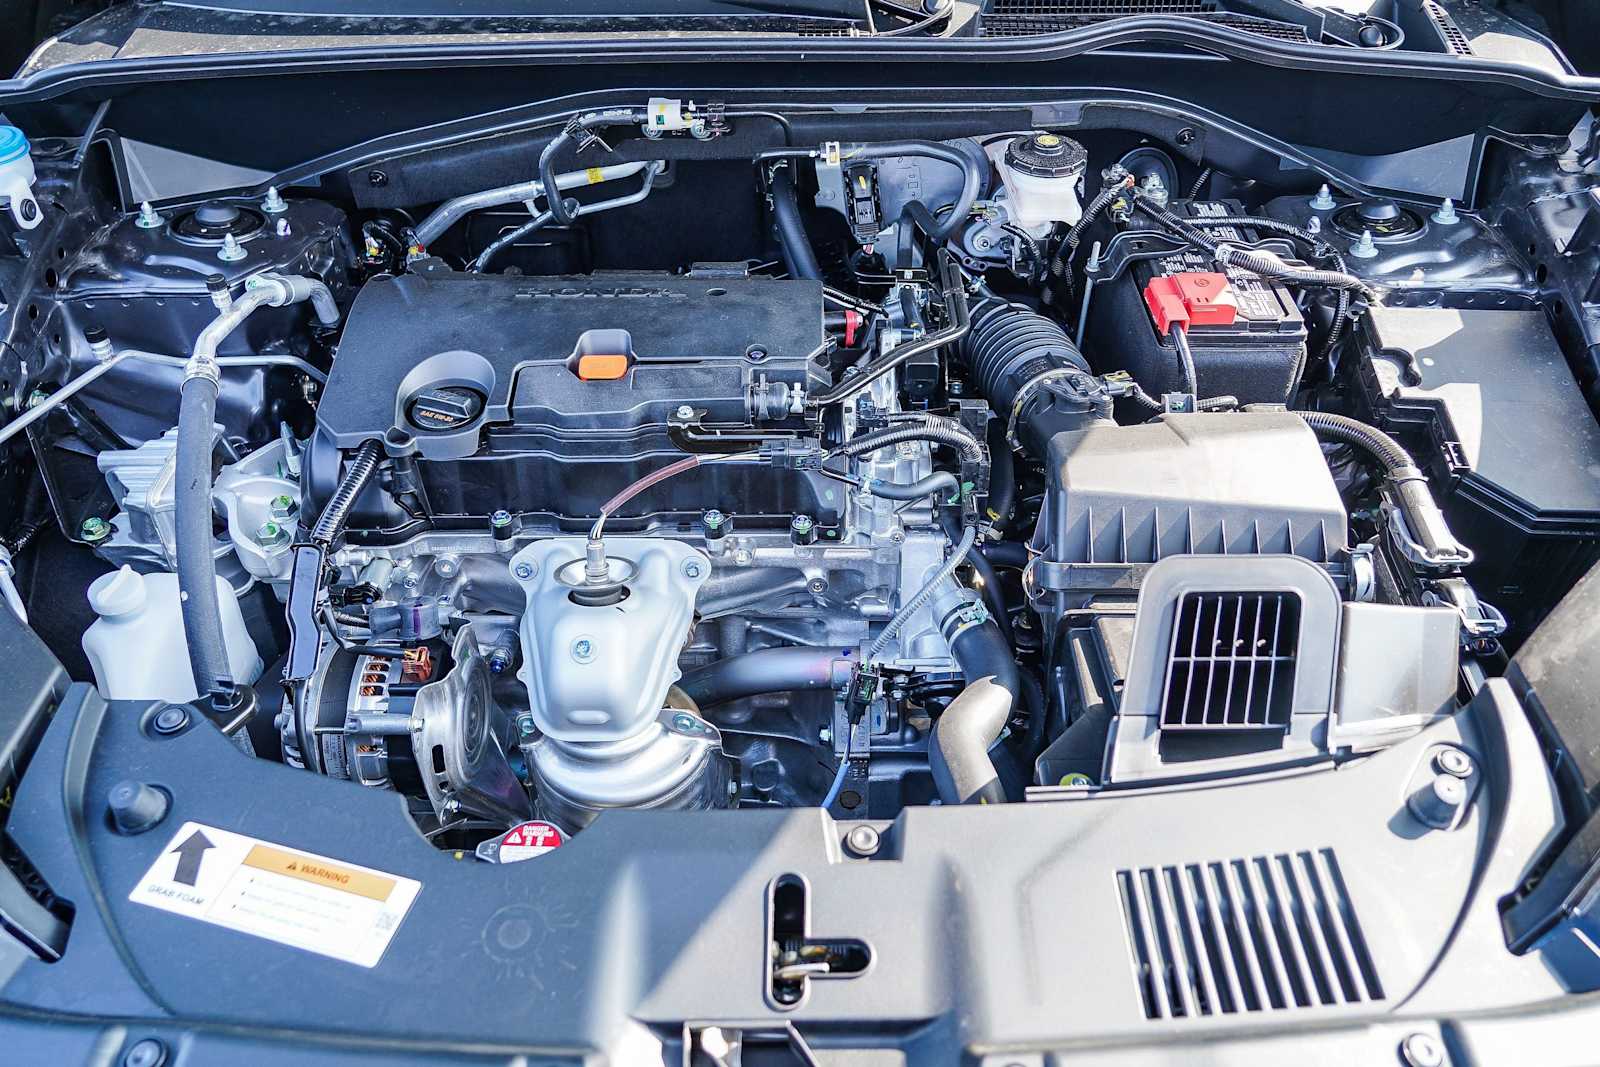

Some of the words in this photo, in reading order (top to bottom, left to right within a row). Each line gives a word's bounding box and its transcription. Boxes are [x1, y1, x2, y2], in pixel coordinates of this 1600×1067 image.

[515, 286, 687, 298] HONDA
[300, 863, 351, 885] WARNING
[147, 884, 175, 898] GRAB
[176, 889, 206, 906] FOAM
